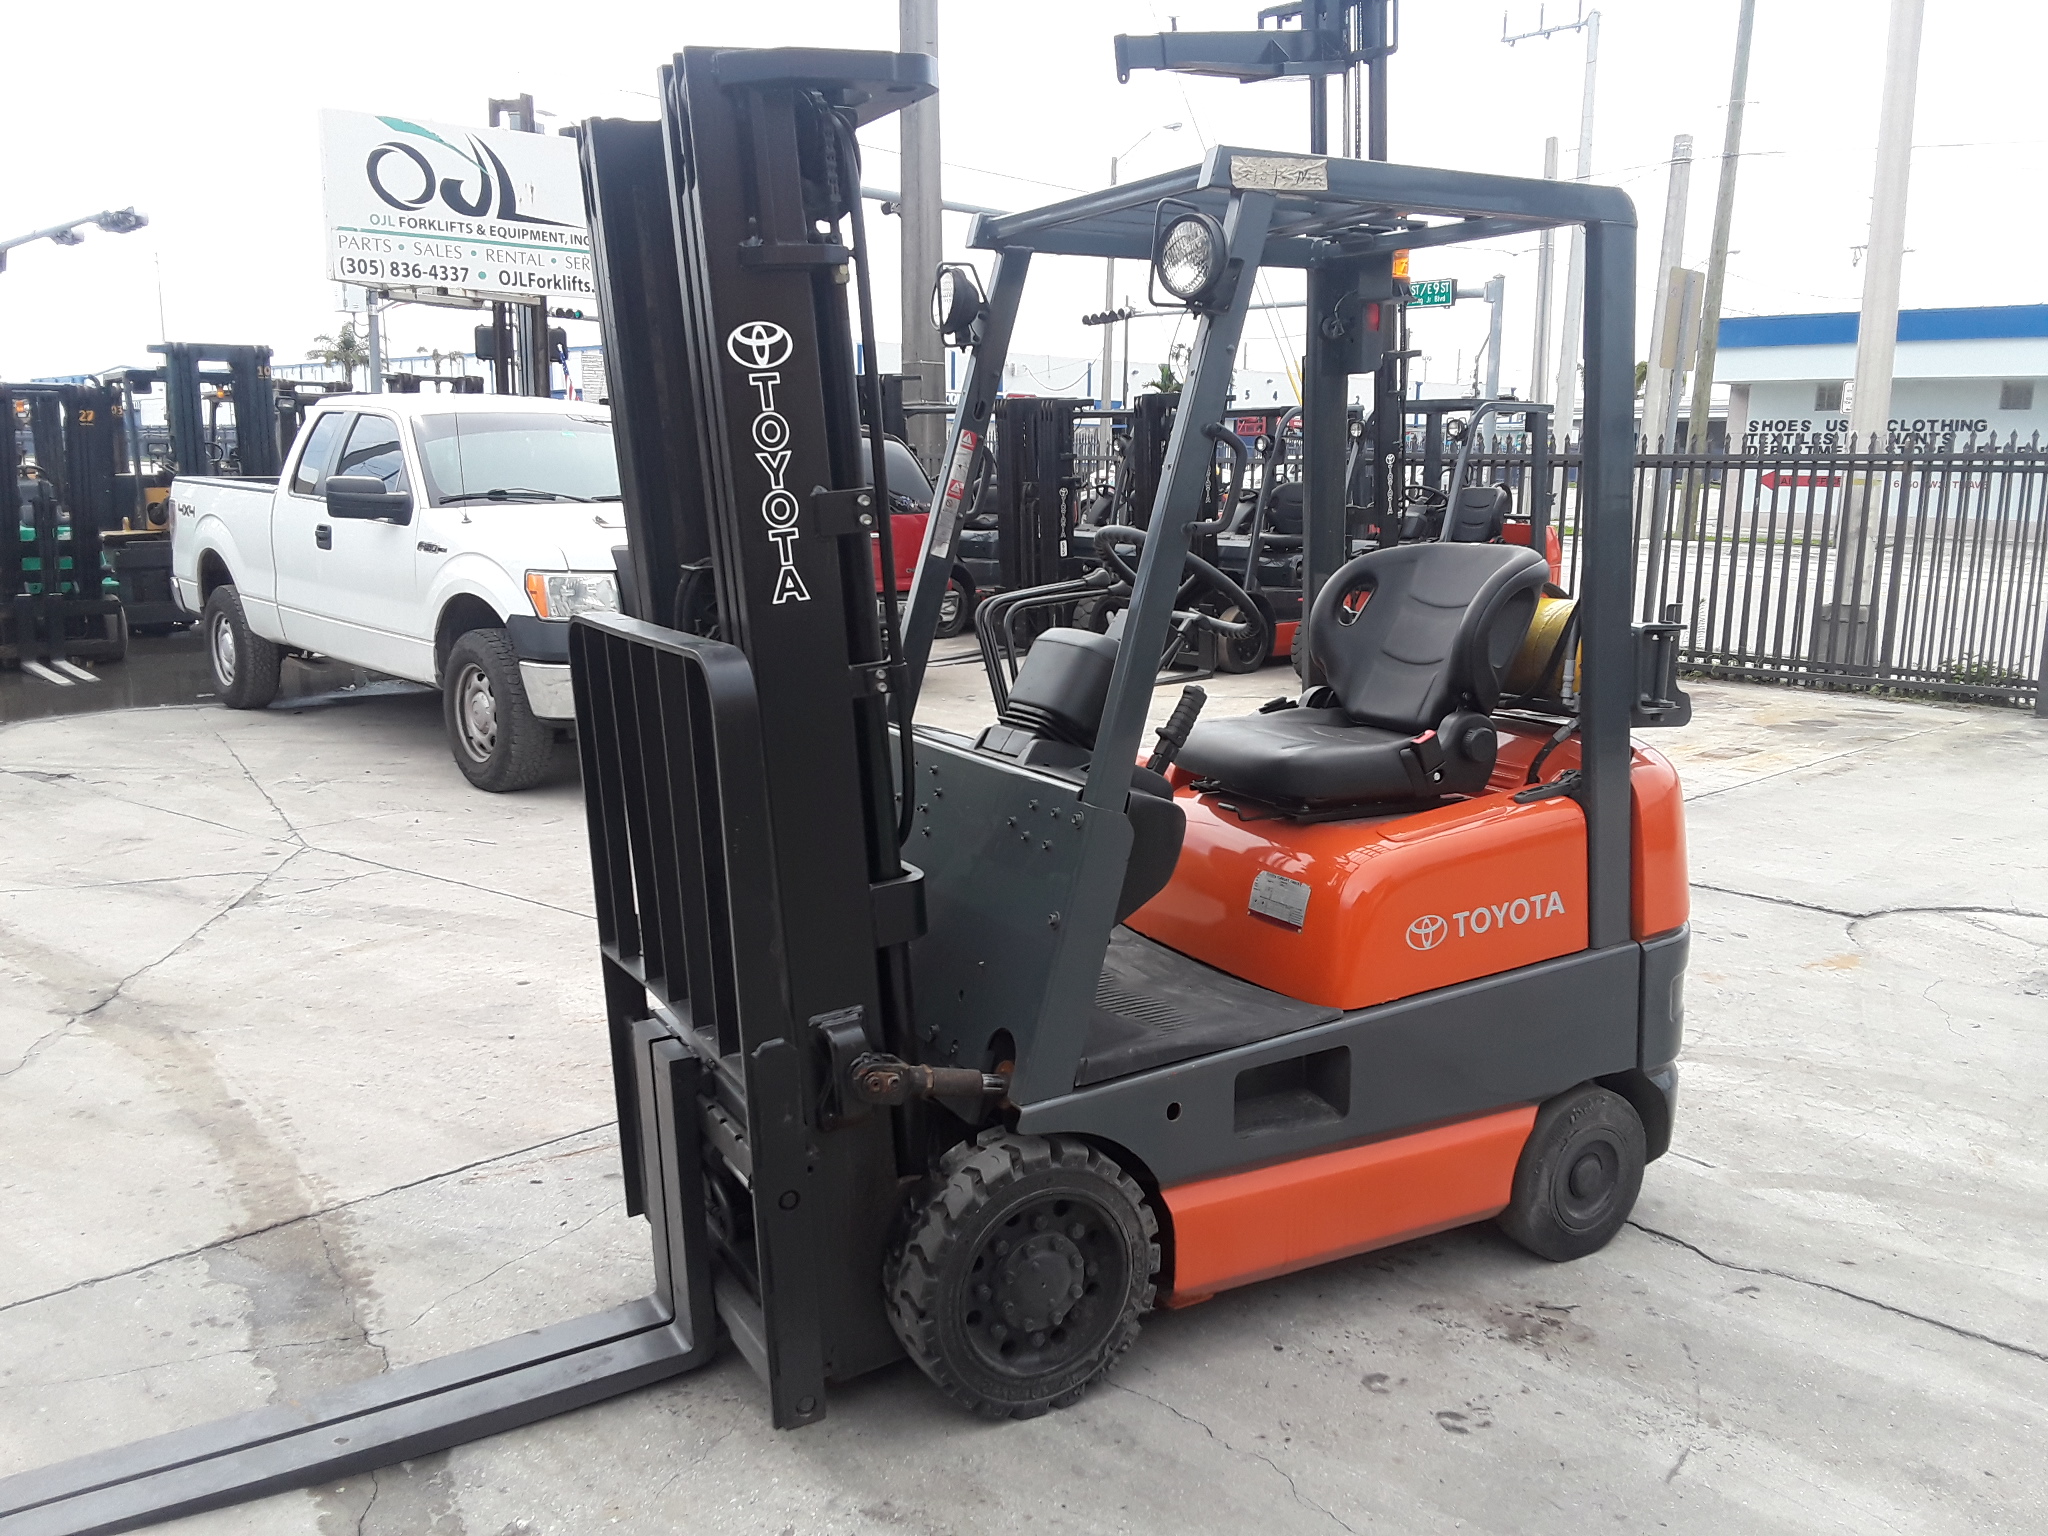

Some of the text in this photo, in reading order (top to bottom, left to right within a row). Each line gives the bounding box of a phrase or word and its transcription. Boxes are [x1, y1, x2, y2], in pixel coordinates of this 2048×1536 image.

[367, 133, 587, 229] OJL
[369, 213, 395, 228] OJL
[399, 216, 473, 235] FORKLIFTS
[476, 224, 486, 236] &
[490, 225, 567, 246] EQUIPMENT,
[338, 235, 392, 253] PARTS
[413, 242, 462, 259] SALES
[486, 249, 545, 267] RENTAL
[340, 255, 385, 278] (305)
[390, 261, 469, 282] 836-4337
[1433, 282, 1439, 293] 9
[1440, 282, 1450, 293] ST
[1245, 389, 1251, 400] 5
[1272, 391, 1278, 401] 4
[78, 409, 95, 422] 27
[1748, 420, 1812, 432] SHOES
[1887, 419, 1988, 432] CLOTHING
[1747, 433, 1835, 445] TEXTLES
[748, 372, 812, 605] TOYOTA
[1452, 891, 1565, 937] TOYOTA
